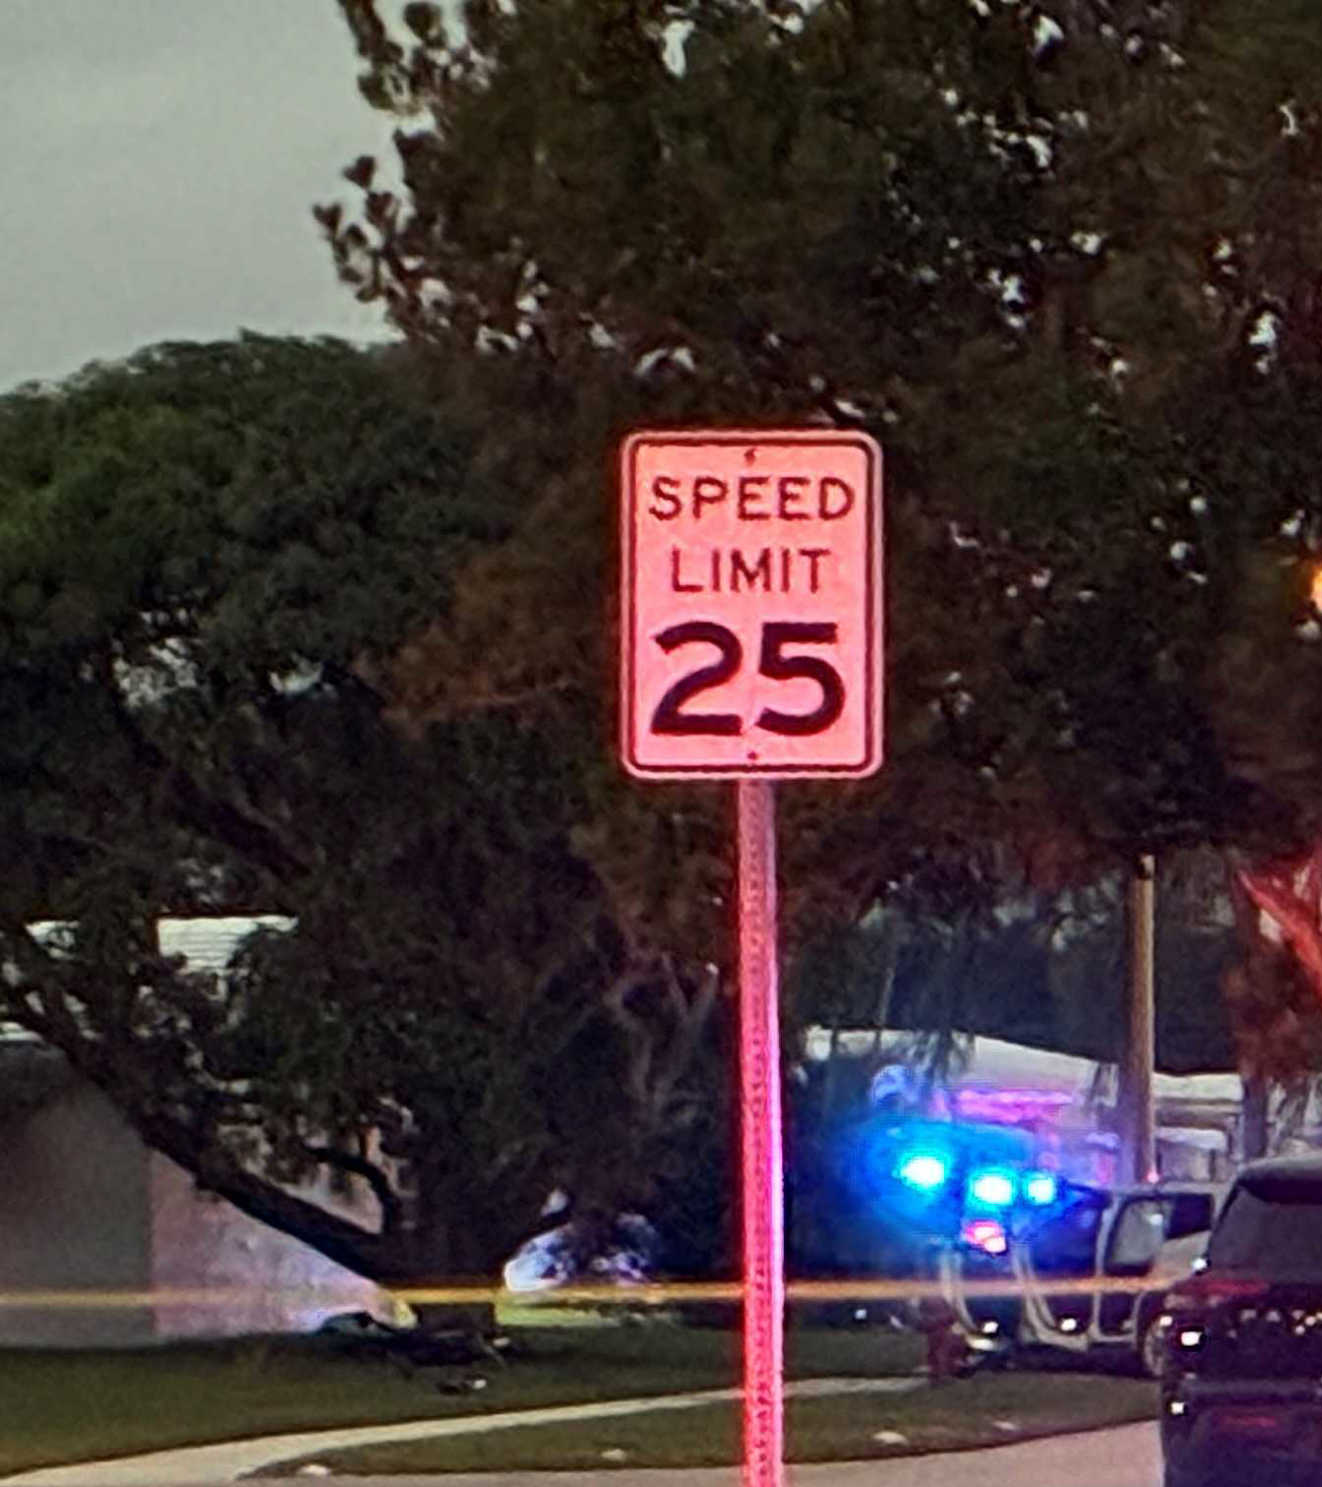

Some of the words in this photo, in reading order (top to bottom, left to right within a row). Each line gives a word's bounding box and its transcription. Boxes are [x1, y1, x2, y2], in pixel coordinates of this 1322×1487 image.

[649, 475, 855, 521] SPEED
[671, 546, 832, 593] LIMIT
[650, 620, 847, 738] 25
